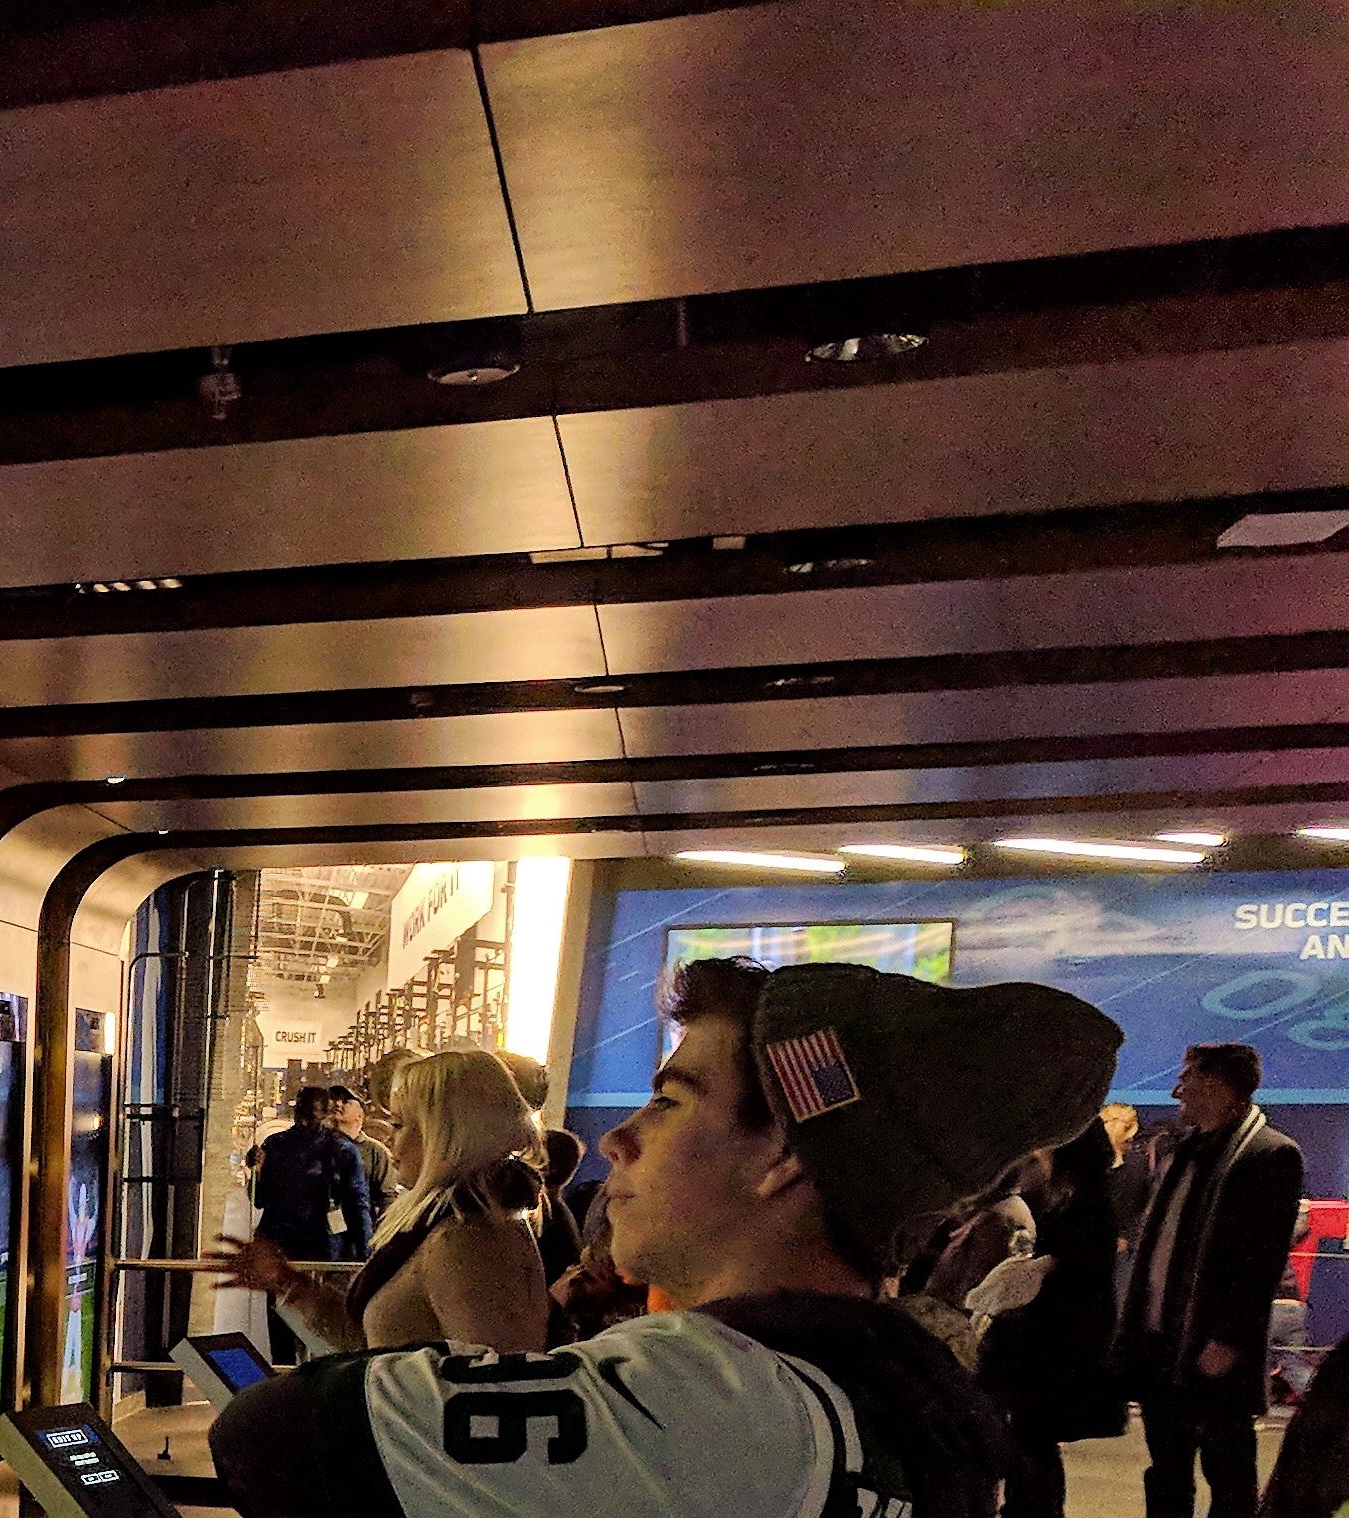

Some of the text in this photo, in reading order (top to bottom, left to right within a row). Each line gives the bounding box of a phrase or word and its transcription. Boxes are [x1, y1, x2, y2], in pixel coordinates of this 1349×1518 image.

[428, 874, 447, 922] FOR
[1234, 901, 1349, 930] SUCCE
[1299, 933, 1349, 960] AN
[275, 1030, 317, 1044] CRUSH IT
